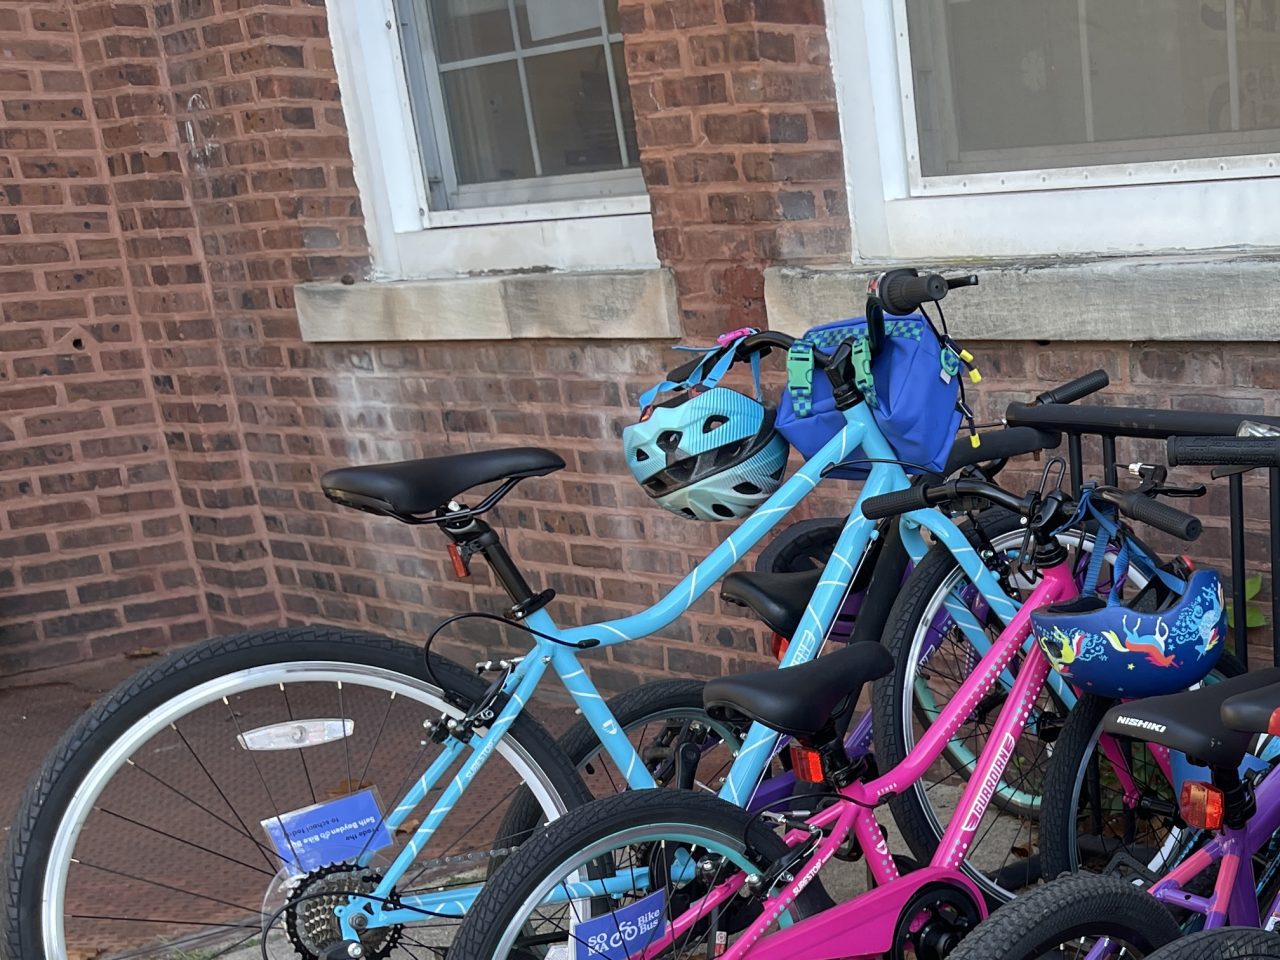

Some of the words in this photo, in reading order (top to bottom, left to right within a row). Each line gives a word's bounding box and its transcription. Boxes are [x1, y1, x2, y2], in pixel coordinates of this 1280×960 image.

[1116, 715, 1167, 733] NISHIKI
[971, 747, 1011, 818] GUARDIAN
[792, 858, 823, 897] SURESTOP
[637, 909, 660, 927] Bike
[639, 919, 659, 936] Bus
[588, 933, 608, 948] SO
[588, 943, 610, 957] MA
